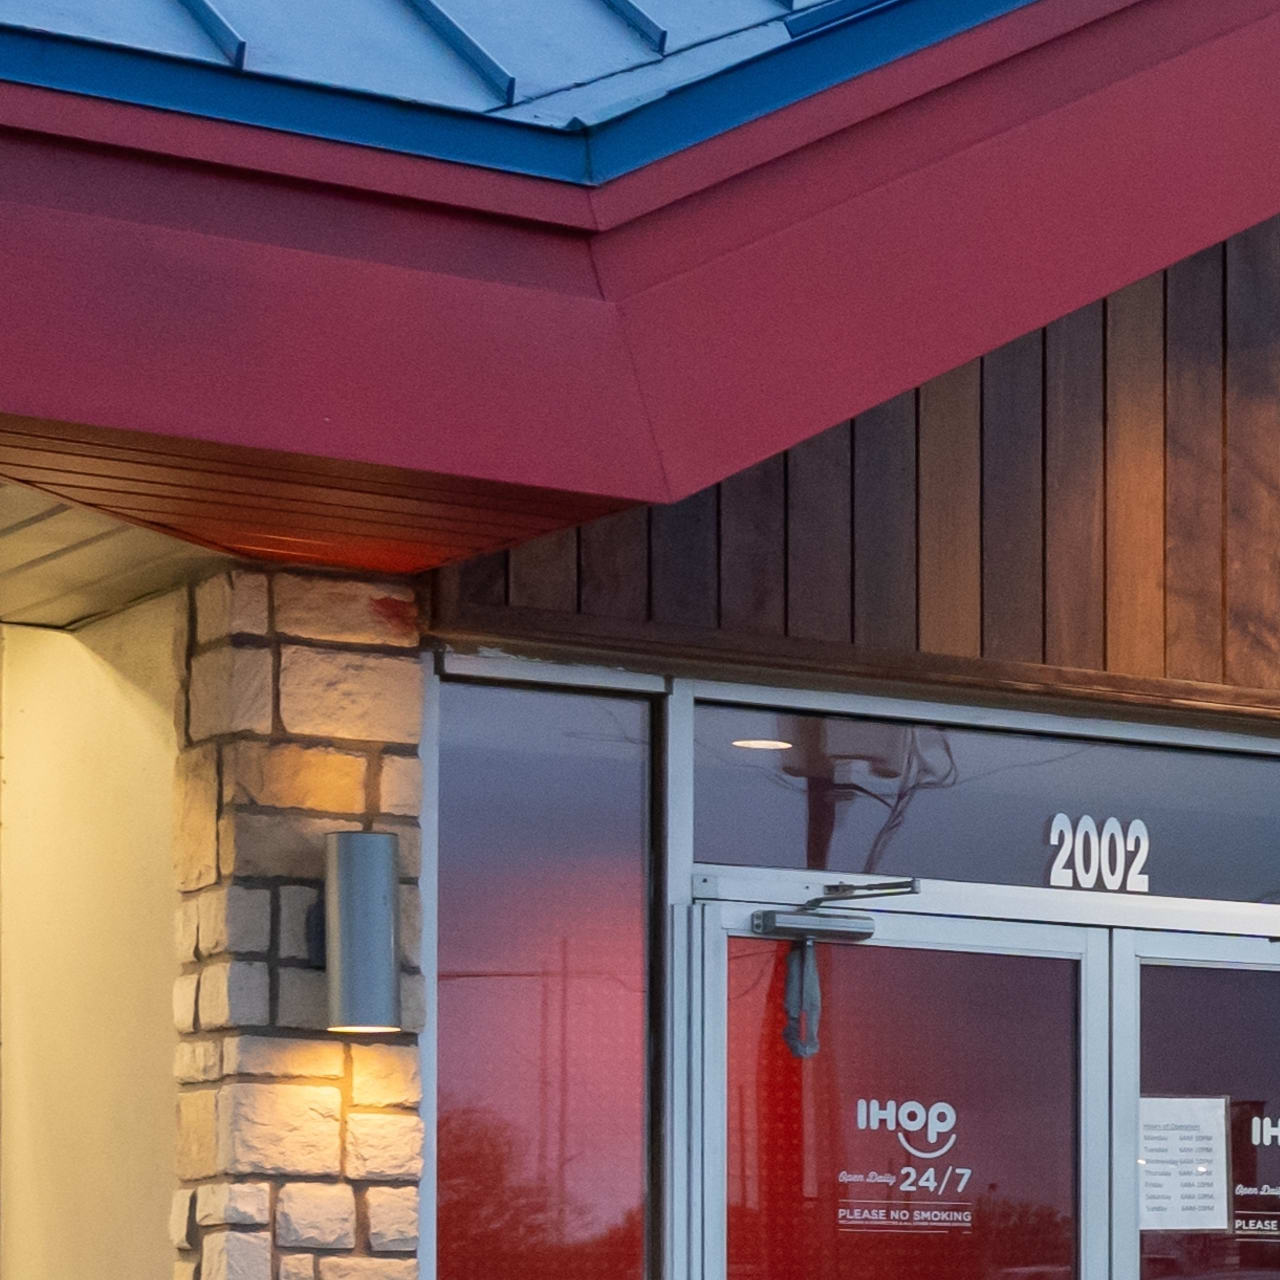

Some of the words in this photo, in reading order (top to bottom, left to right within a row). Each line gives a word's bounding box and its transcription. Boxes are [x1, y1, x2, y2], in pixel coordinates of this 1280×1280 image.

[1050, 812, 1150, 893] 2002
[900, 1166, 972, 1195] 24/7
[838, 1209, 887, 1220] PLEASE
[890, 1210, 910, 1220] NO
[913, 1210, 972, 1222] SMOKING
[1235, 1219, 1278, 1230] PLEASE
